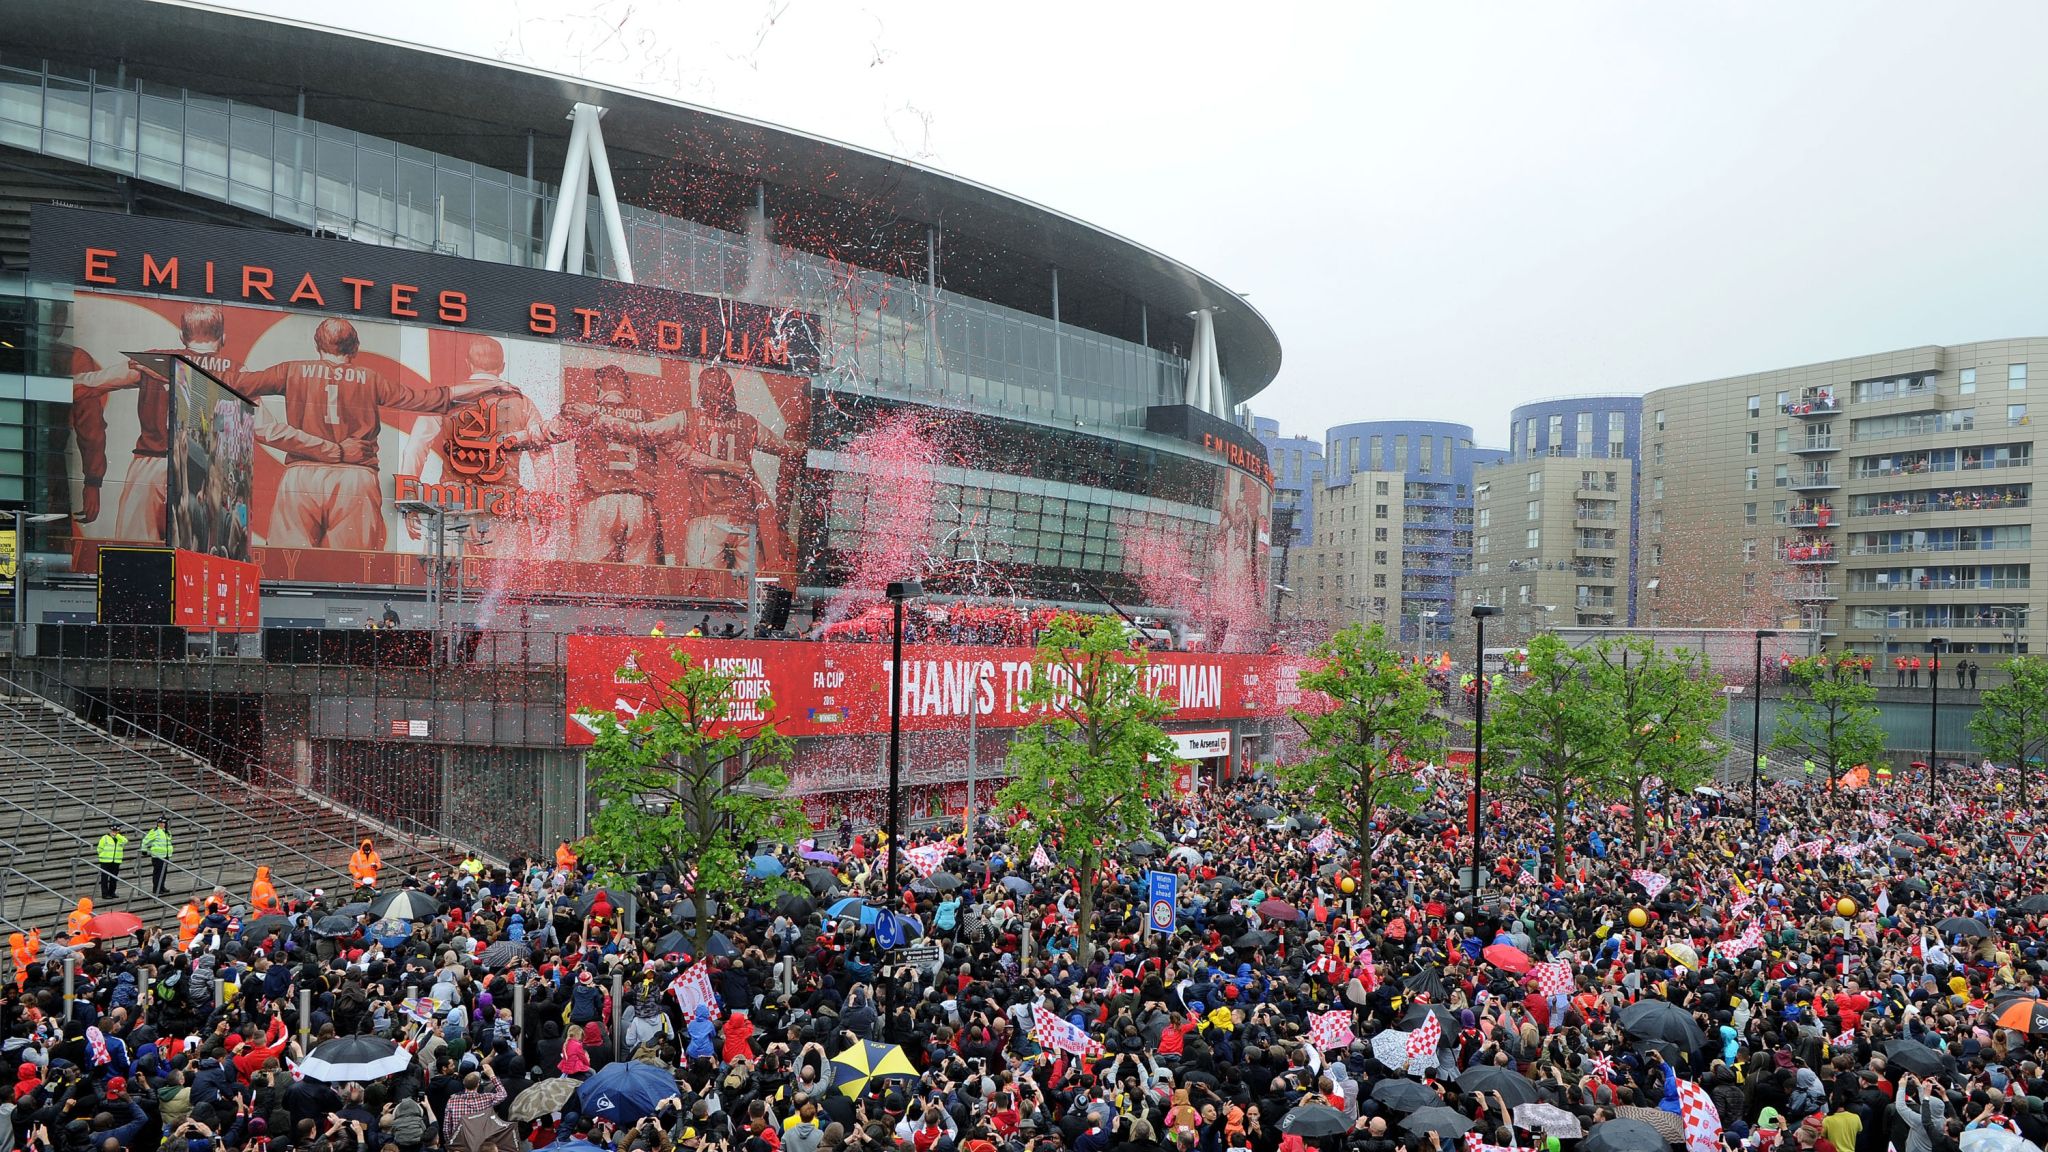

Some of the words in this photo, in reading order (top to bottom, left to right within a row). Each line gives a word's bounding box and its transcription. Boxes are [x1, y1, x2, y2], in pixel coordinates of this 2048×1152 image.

[85, 248, 468, 322] EMIRATES
[530, 303, 788, 364] STADIUM
[302, 364, 367, 385] WILSON
[324, 384, 341, 424] 1
[1203, 432, 1261, 476] EMIRATES
[393, 474, 566, 519] Emirates
[712, 657, 765, 678] ARSENAL
[813, 671, 825, 688] FA
[826, 671, 845, 688] CUP
[883, 660, 996, 717] THANKS
[1002, 661, 1033, 714] TO
[1179, 664, 1222, 709] MAN
[823, 695, 835, 706] 2015
[1189, 739, 1199, 749] The
[1200, 738, 1220, 749] Arsenal
[2010, 835, 2028, 843] GIVE
[1156, 875, 1171, 883] Width
[1157, 882, 1170, 891] Limit
[1155, 890, 1171, 898] ahead
